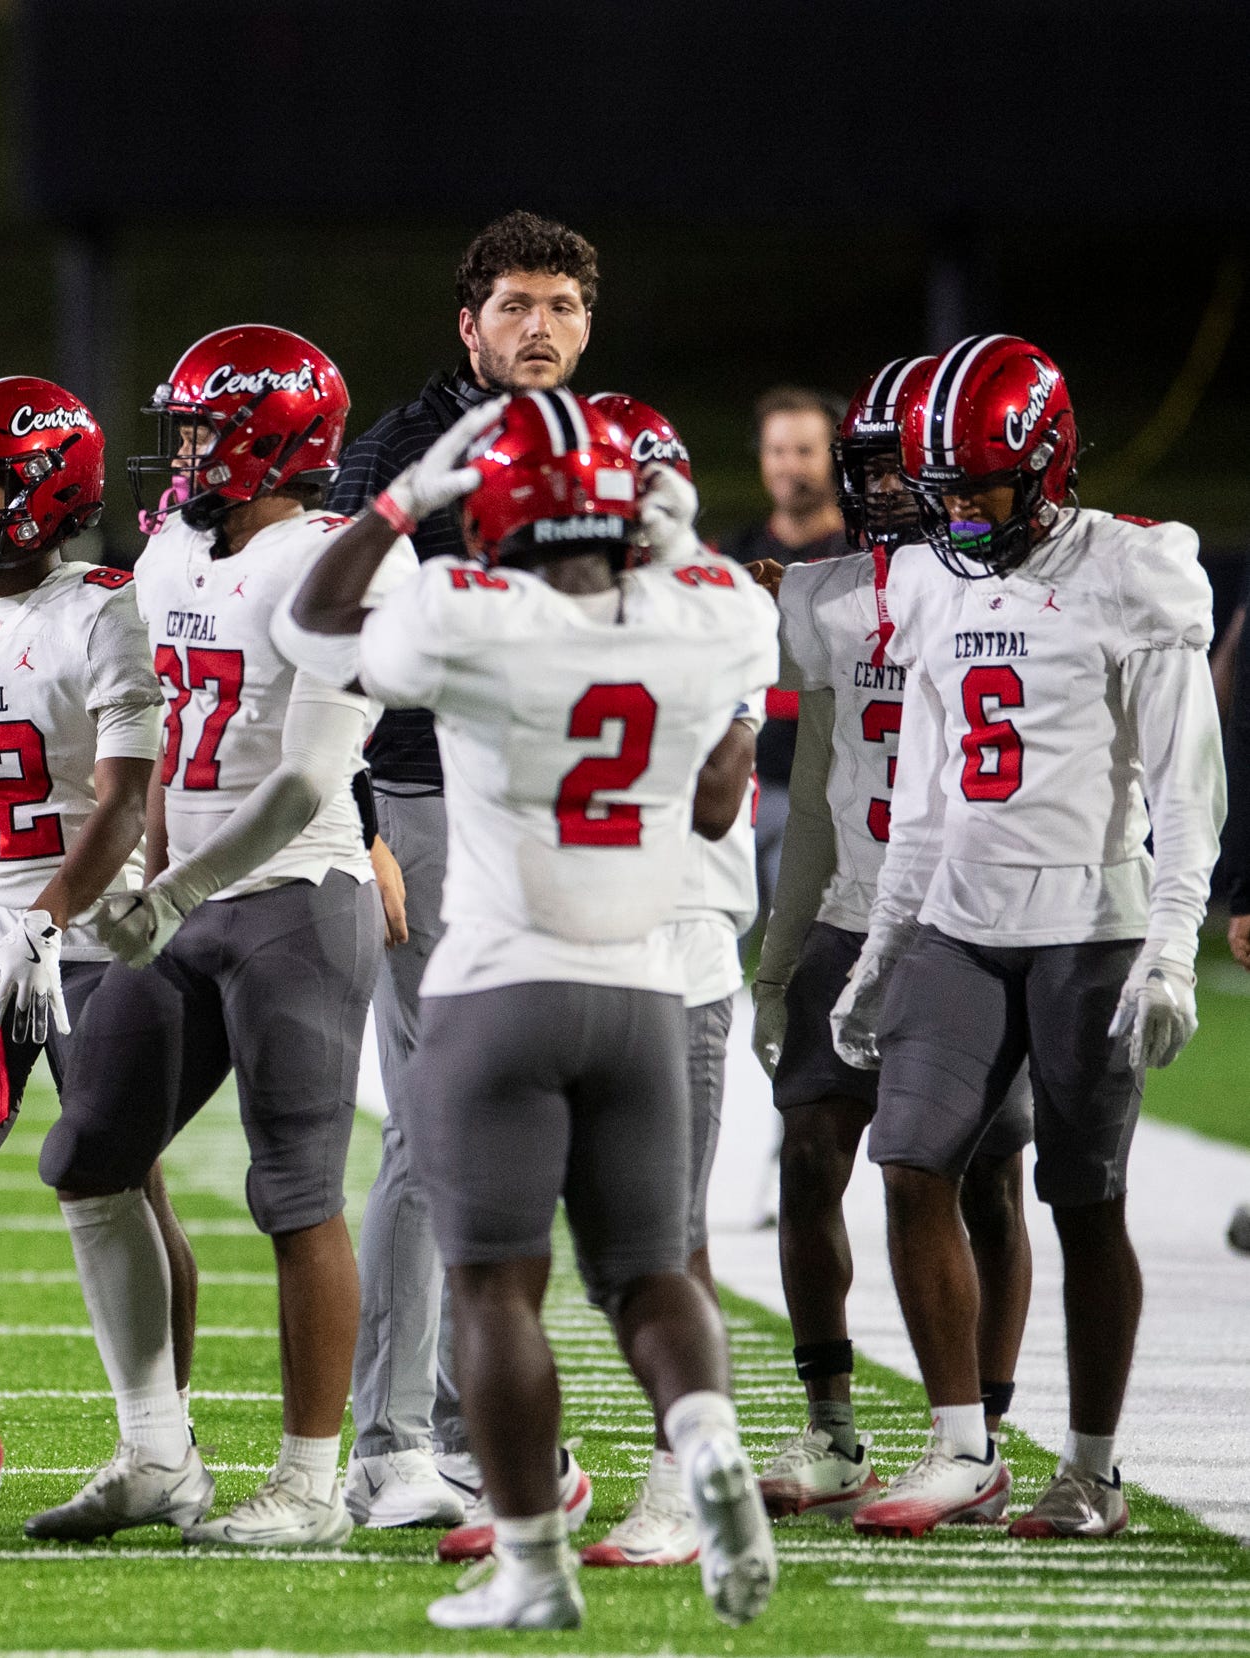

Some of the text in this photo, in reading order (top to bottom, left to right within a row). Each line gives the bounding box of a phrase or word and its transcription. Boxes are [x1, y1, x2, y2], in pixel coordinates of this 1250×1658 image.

[203, 364, 312, 399] Central
[856, 421, 895, 432] Riddell
[534, 515, 624, 543] Riddell
[166, 611, 217, 641] CENTRAL
[955, 632, 1028, 659] CENTRAL
[153, 643, 245, 790] 37
[960, 664, 1025, 803] 6
[554, 682, 658, 847] 2
